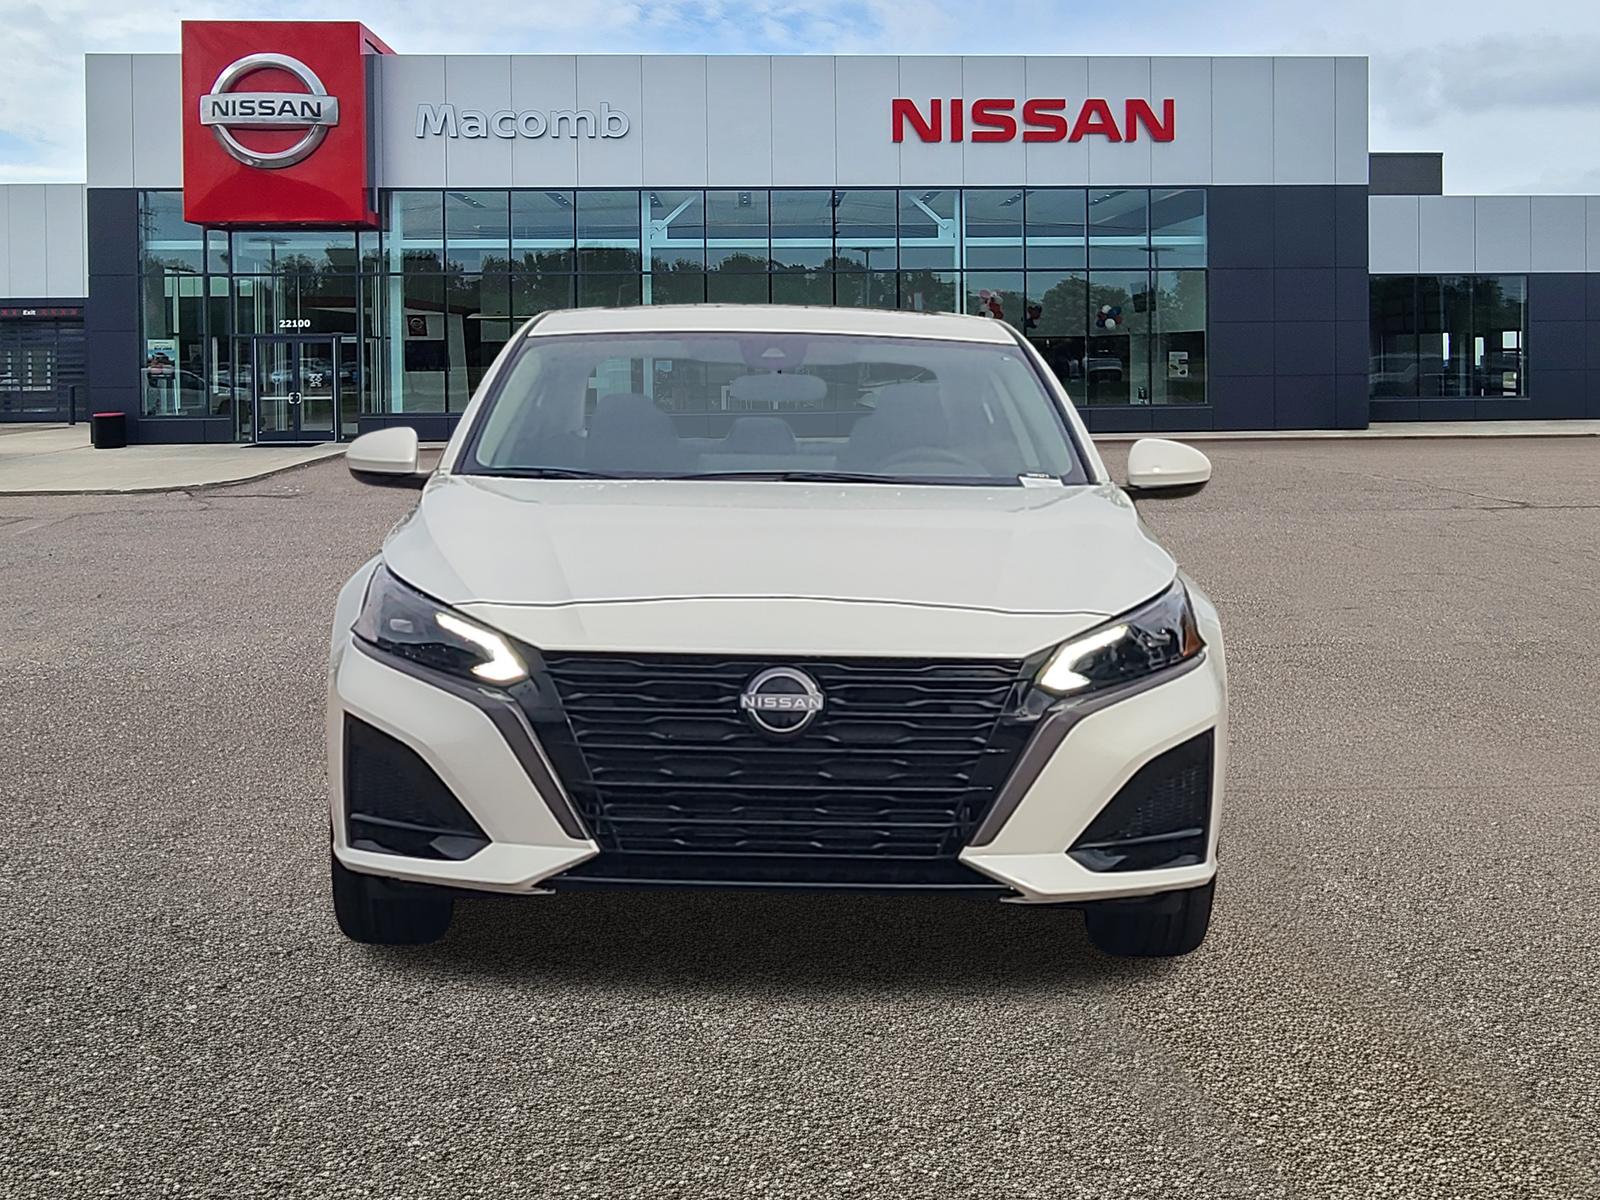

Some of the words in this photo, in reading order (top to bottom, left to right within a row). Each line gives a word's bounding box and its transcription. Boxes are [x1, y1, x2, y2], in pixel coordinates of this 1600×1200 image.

[211, 100, 322, 118] NISSAN
[415, 101, 630, 139] Macomb
[892, 98, 1175, 142] NISSAN
[279, 319, 311, 328] 22100
[741, 696, 822, 709] NISSAN
